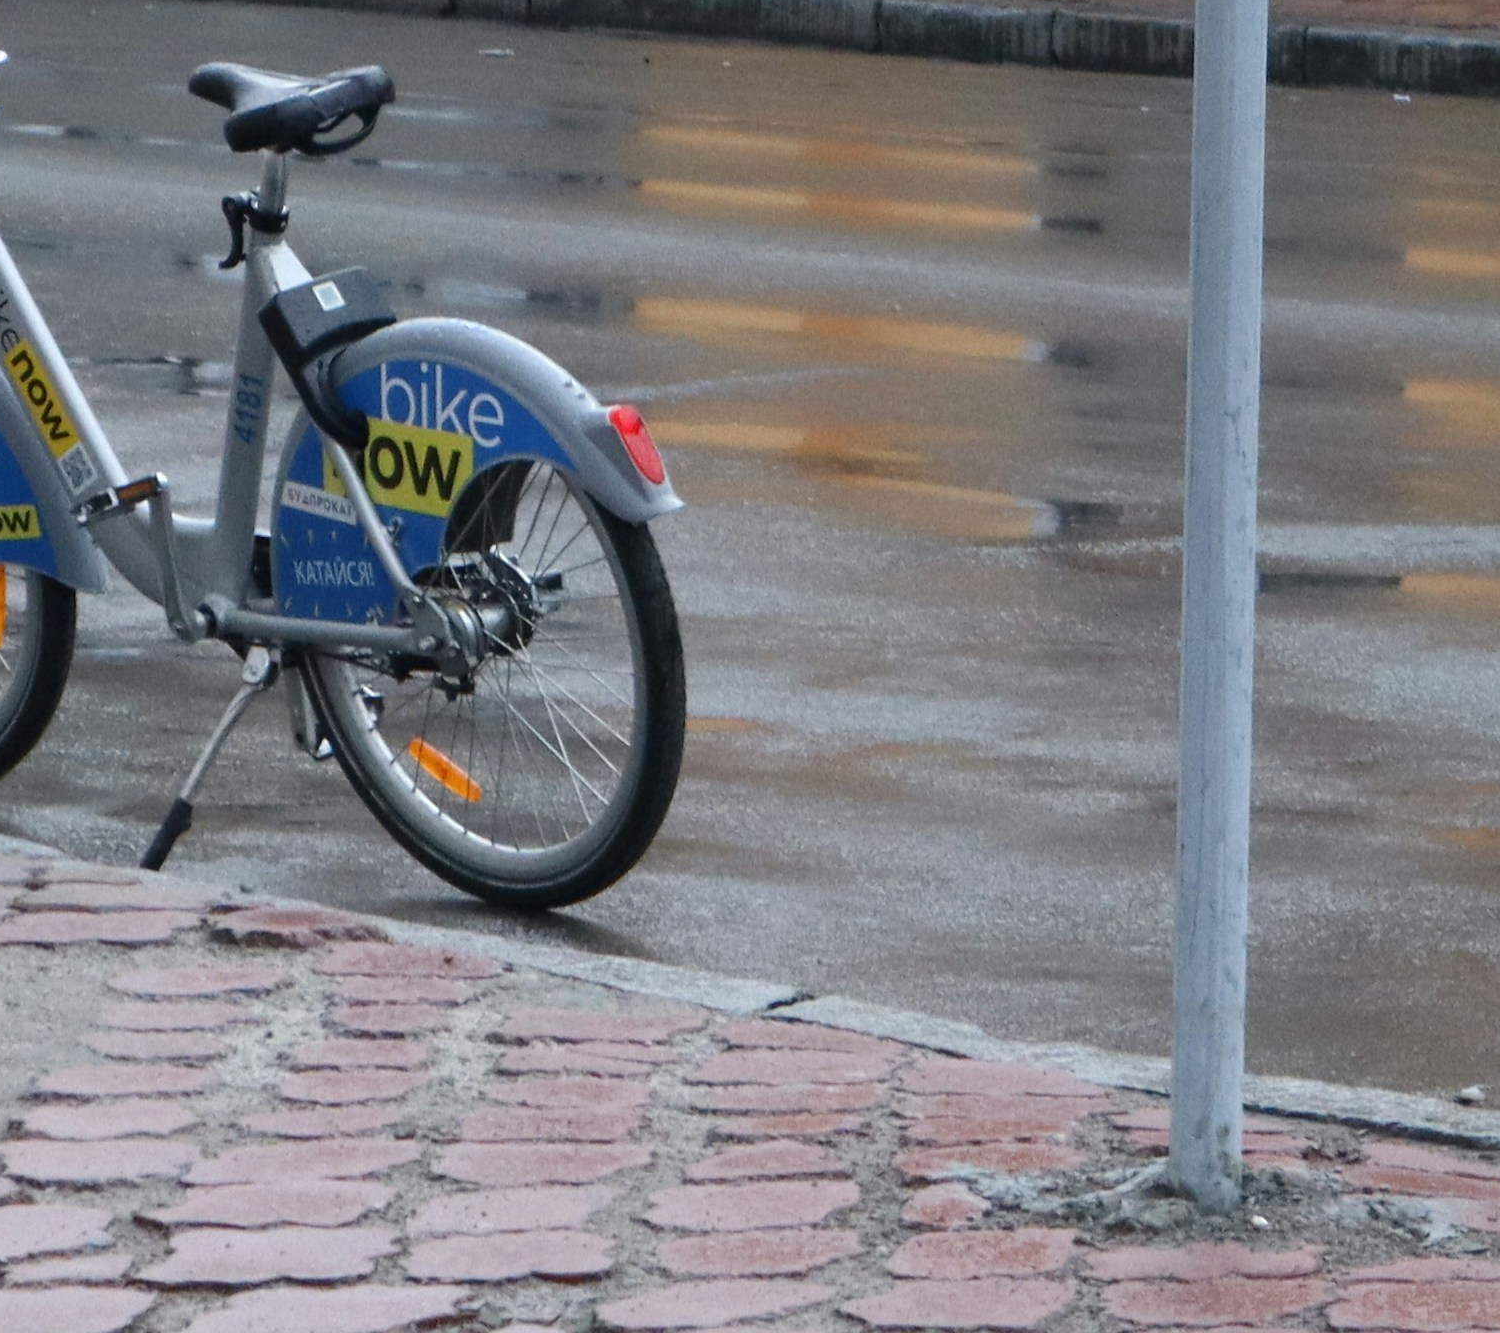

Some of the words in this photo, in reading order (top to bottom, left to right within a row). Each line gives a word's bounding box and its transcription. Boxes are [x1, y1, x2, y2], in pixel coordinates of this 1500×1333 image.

[11, 349, 70, 442] now
[380, 362, 504, 448] bike
[293, 556, 375, 587] КАТАЙСЯ!
